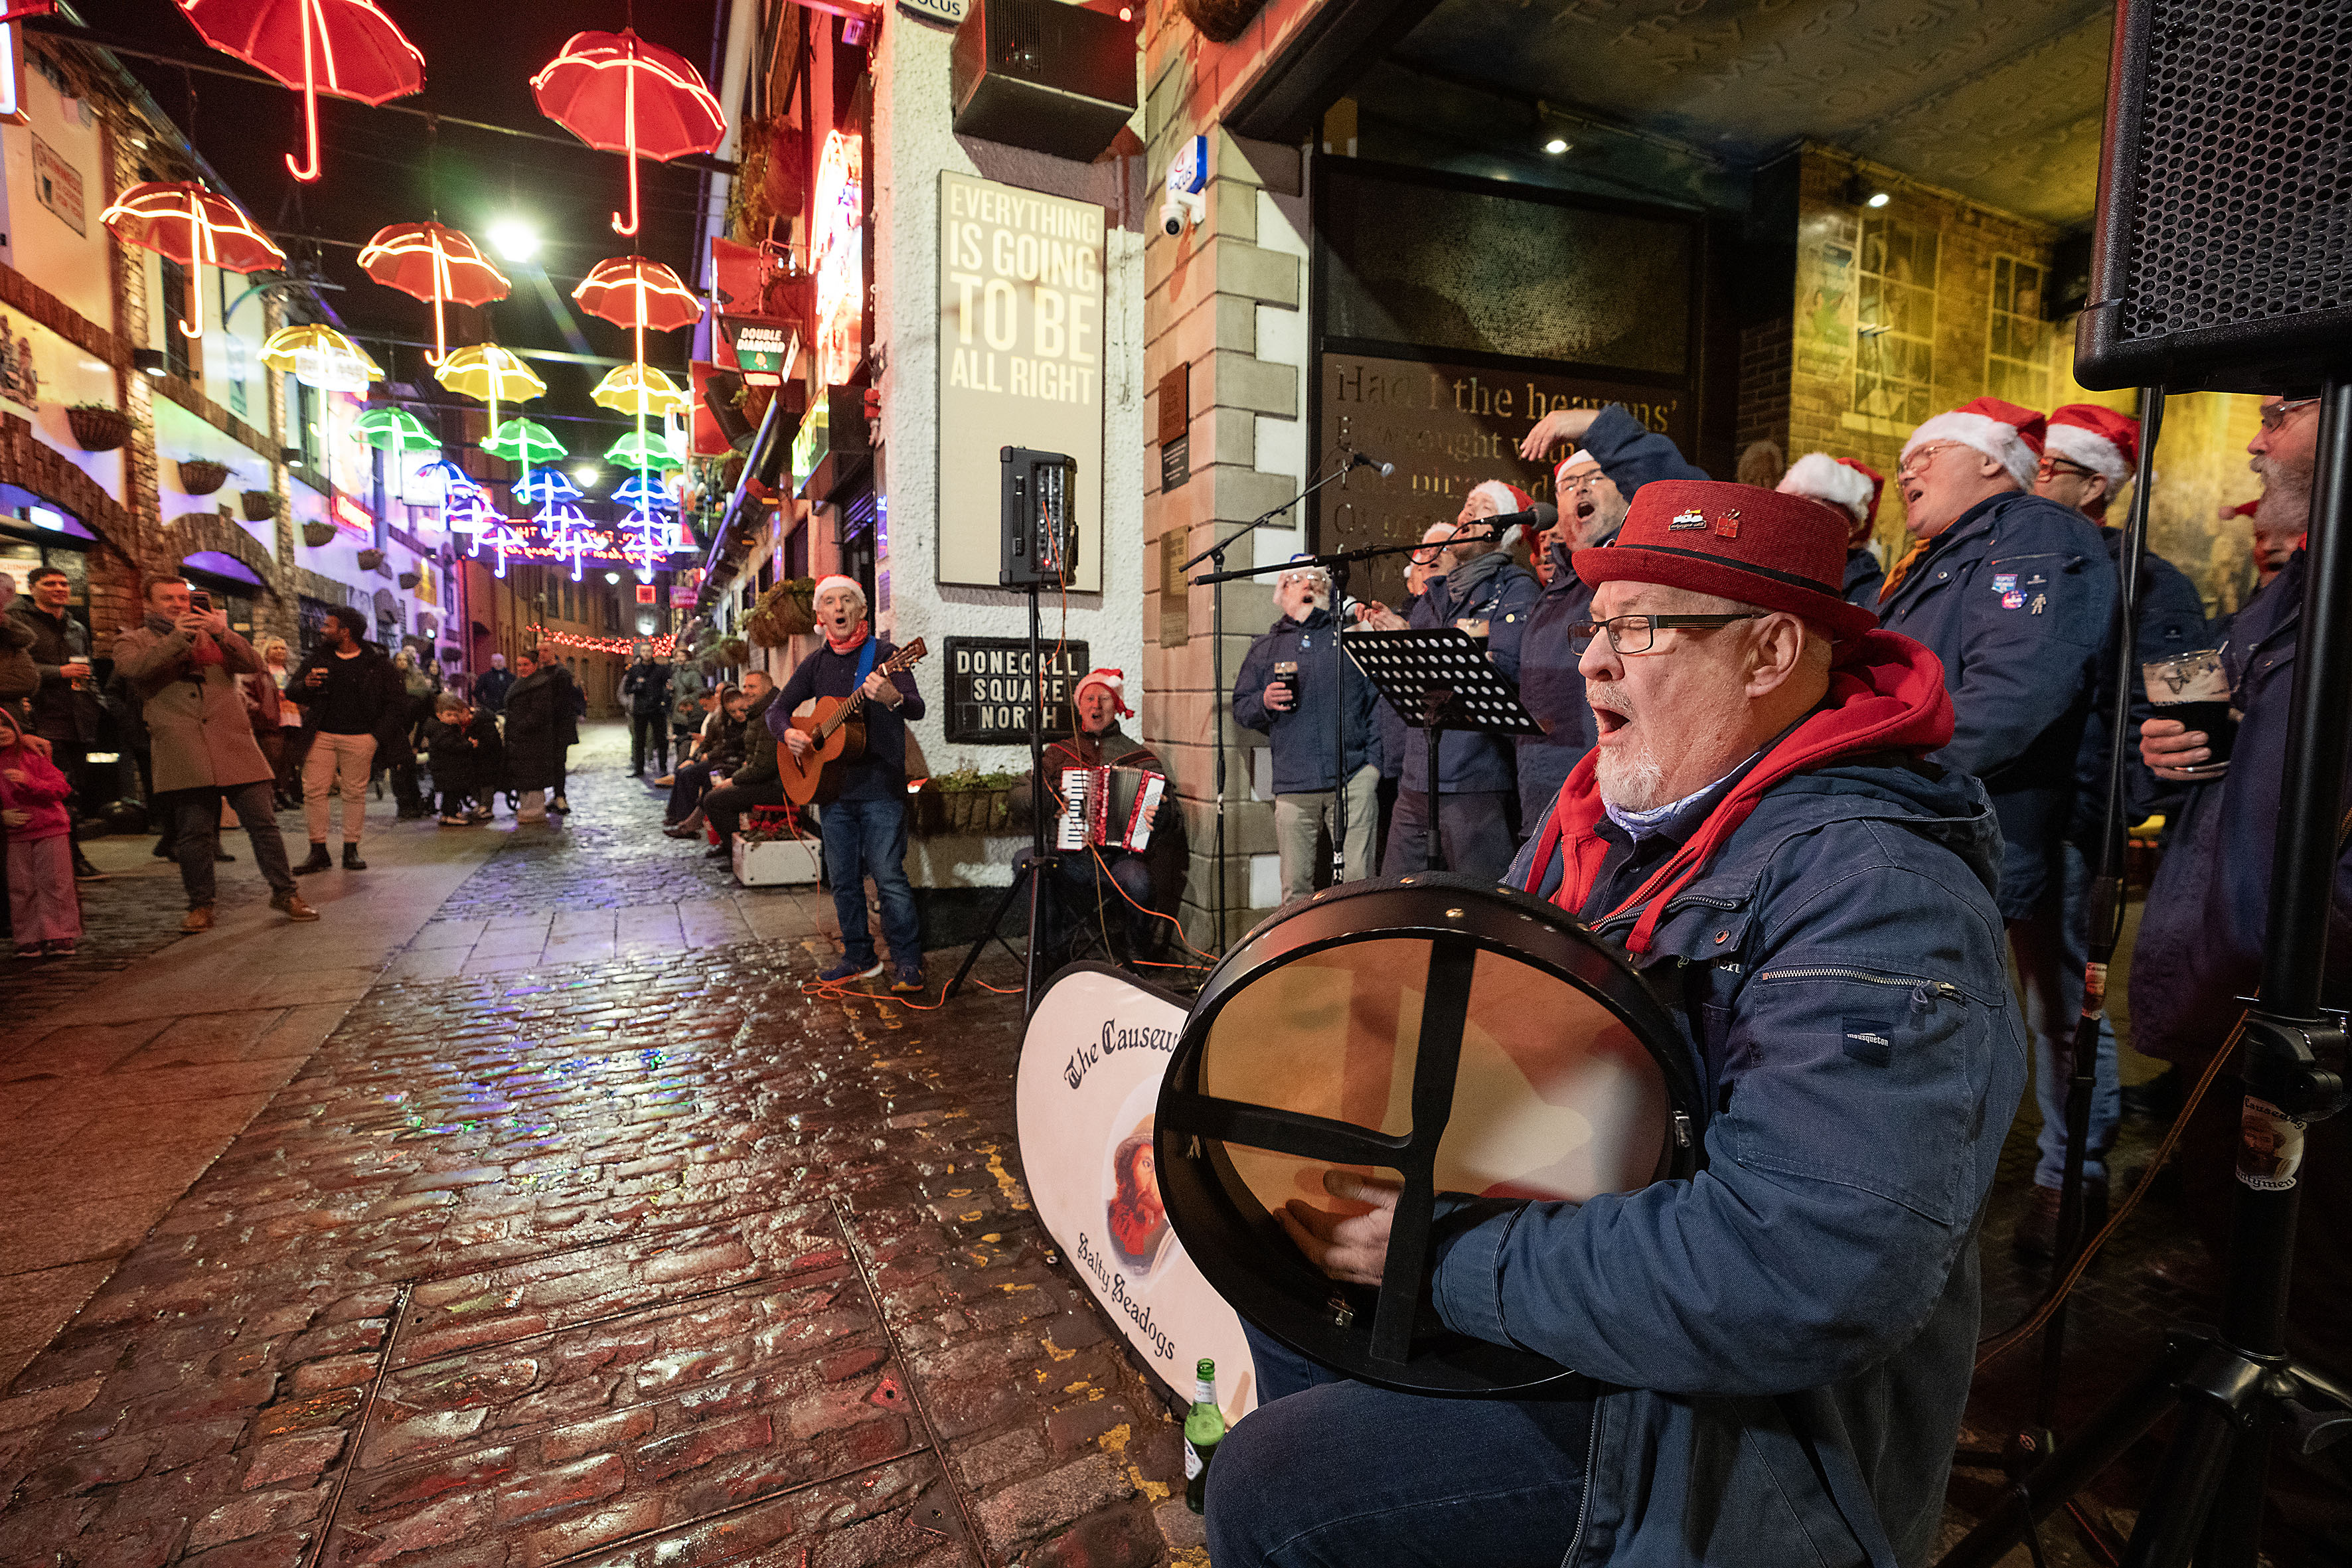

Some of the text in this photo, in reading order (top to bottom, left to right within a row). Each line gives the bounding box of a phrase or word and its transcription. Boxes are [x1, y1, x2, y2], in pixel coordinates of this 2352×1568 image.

[950, 183, 1097, 244] EVERYTHING
[950, 220, 1096, 292] IS GOING
[736, 339, 786, 353] DIAMOND
[740, 327, 783, 341] DOUBLE
[950, 272, 1095, 364] TO BE
[950, 348, 1095, 406] ALL RIGHT
[1452, 376, 1513, 418] the
[1526, 382, 1678, 432] heans'
[981, 705, 1058, 730] NORH
[1063, 1018, 1178, 1089] The Causew
[1847, 1033, 1889, 1046] mousqueton
[1077, 1232, 1176, 1360] Salty Seadogs
